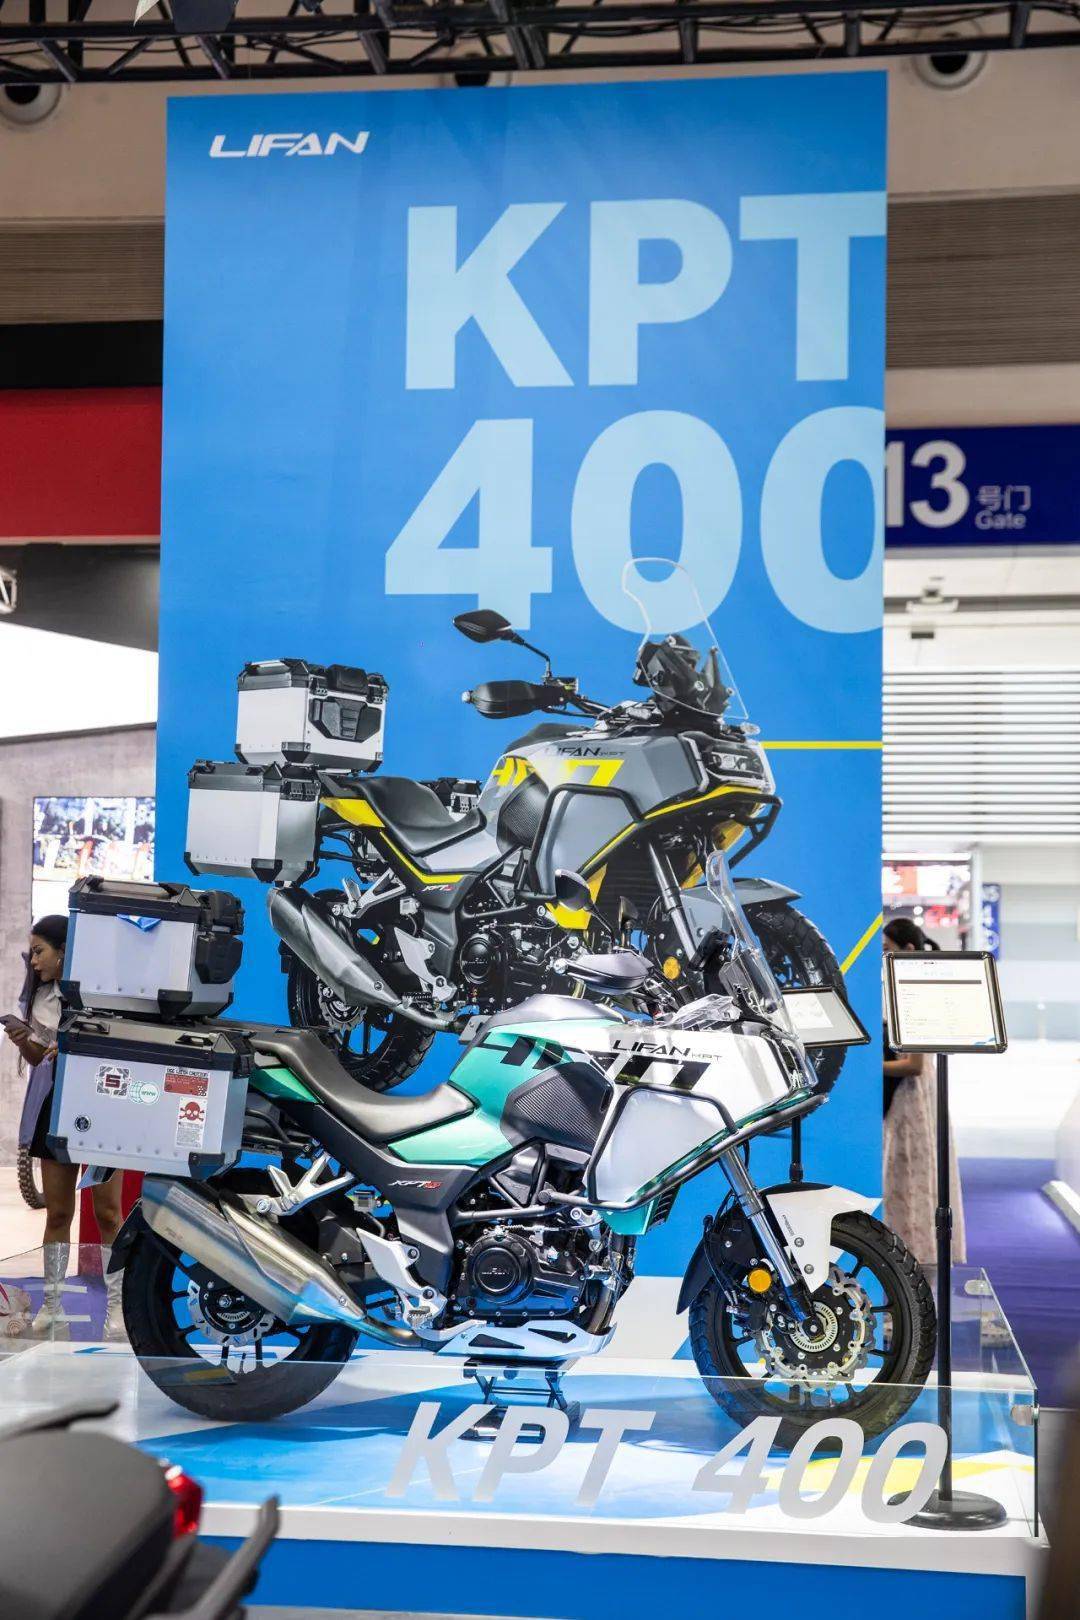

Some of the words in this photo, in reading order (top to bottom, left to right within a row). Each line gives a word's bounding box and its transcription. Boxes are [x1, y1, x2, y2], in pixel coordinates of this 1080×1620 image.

[209, 131, 370, 158] LIFAN
[405, 191, 887, 389] KPT
[885, 440, 970, 528] 13
[385, 406, 885, 635] 400
[975, 509, 1027, 530] Gate
[545, 747, 601, 757] IFAN
[612, 1039, 691, 1057] LIFAN
[384, 1401, 656, 1508] KPT
[691, 1415, 949, 1524] 400
